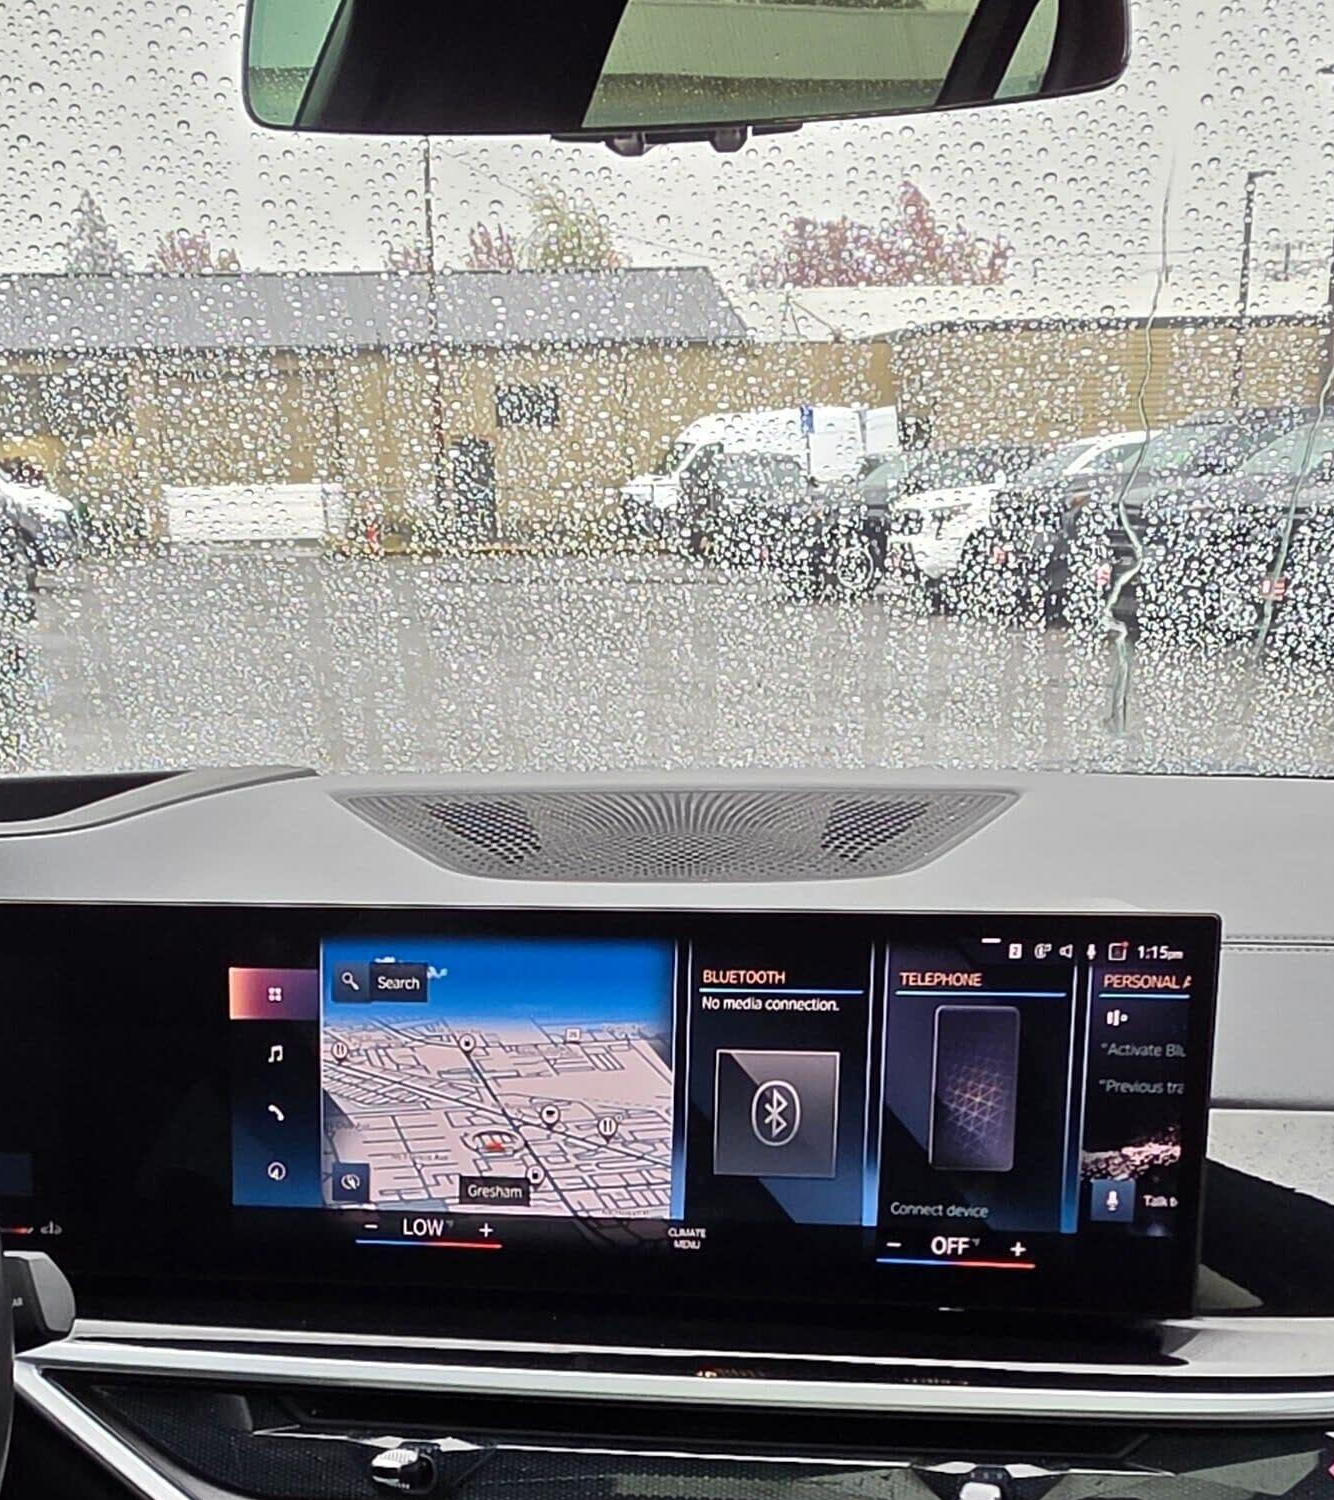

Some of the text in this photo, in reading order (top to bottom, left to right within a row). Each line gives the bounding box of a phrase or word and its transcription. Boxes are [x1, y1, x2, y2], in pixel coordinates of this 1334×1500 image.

[377, 975, 420, 990] Search
[702, 969, 786, 985] BLUETOOTH
[899, 971, 983, 987] TELEPHONE
[1103, 973, 1181, 989] PERSONAL
[702, 996, 840, 1012] No media connection.
[467, 1184, 523, 1199] Gresham
[890, 1201, 989, 1218] Connect device
[403, 1218, 444, 1237] LOW
[668, 1228, 707, 1239] CLIMATE
[673, 1239, 701, 1250] MENU
[930, 1236, 970, 1256] OFF
